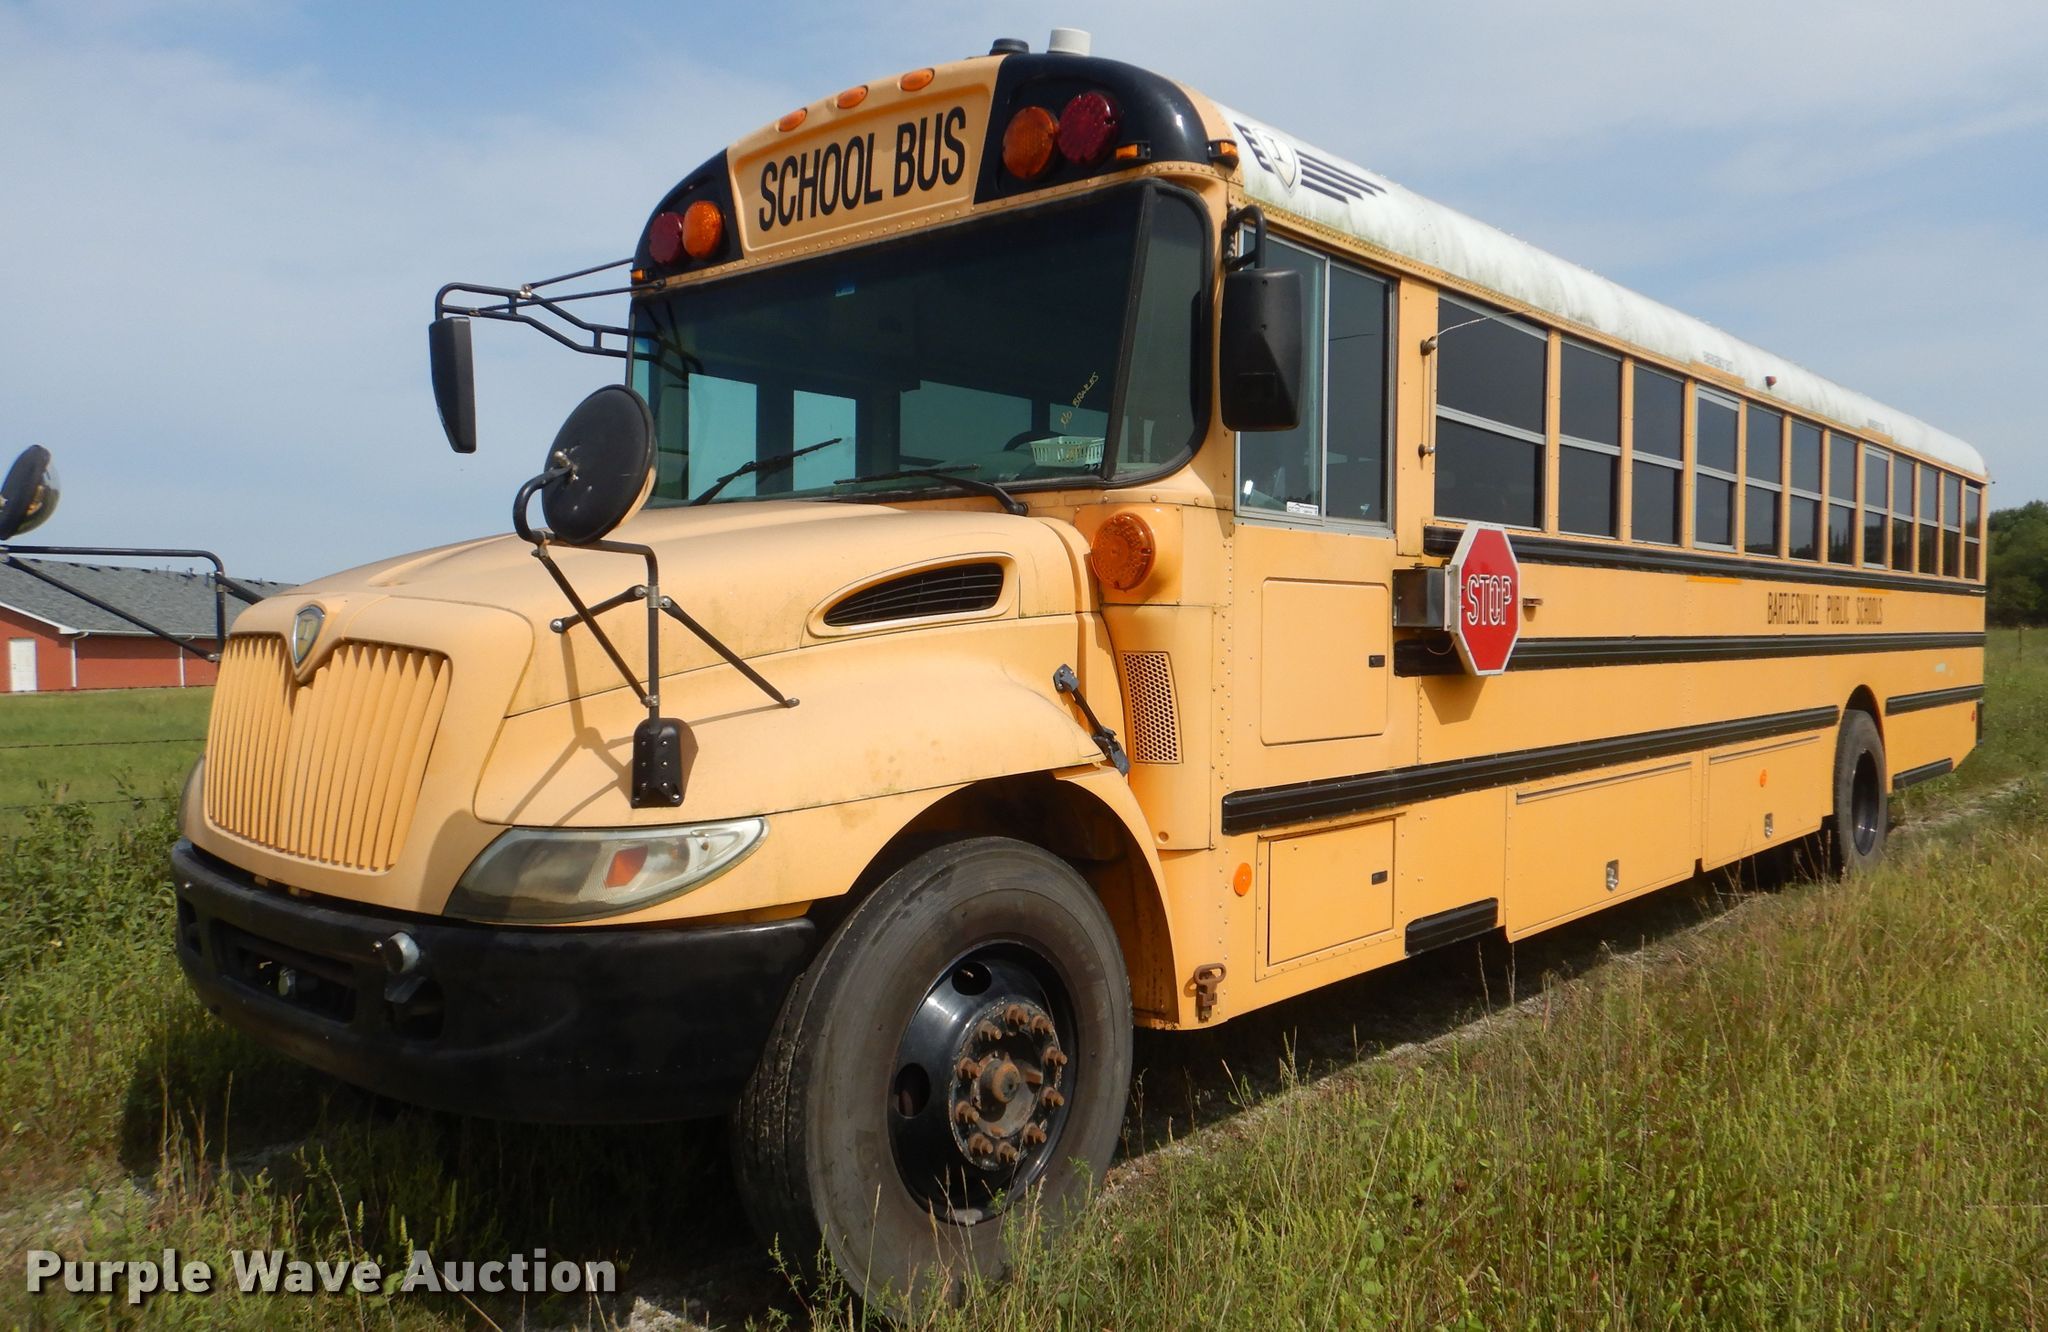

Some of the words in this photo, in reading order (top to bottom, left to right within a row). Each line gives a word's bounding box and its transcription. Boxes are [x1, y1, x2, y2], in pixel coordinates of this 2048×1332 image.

[759, 133, 883, 232] SCHOOL
[893, 106, 966, 197] BUS
[1467, 573, 1513, 626] STOP
[1767, 592, 1820, 625] BARTLESVILLE
[1826, 595, 1851, 625] PUBLIC
[1856, 596, 1884, 625] SCHOOLS
